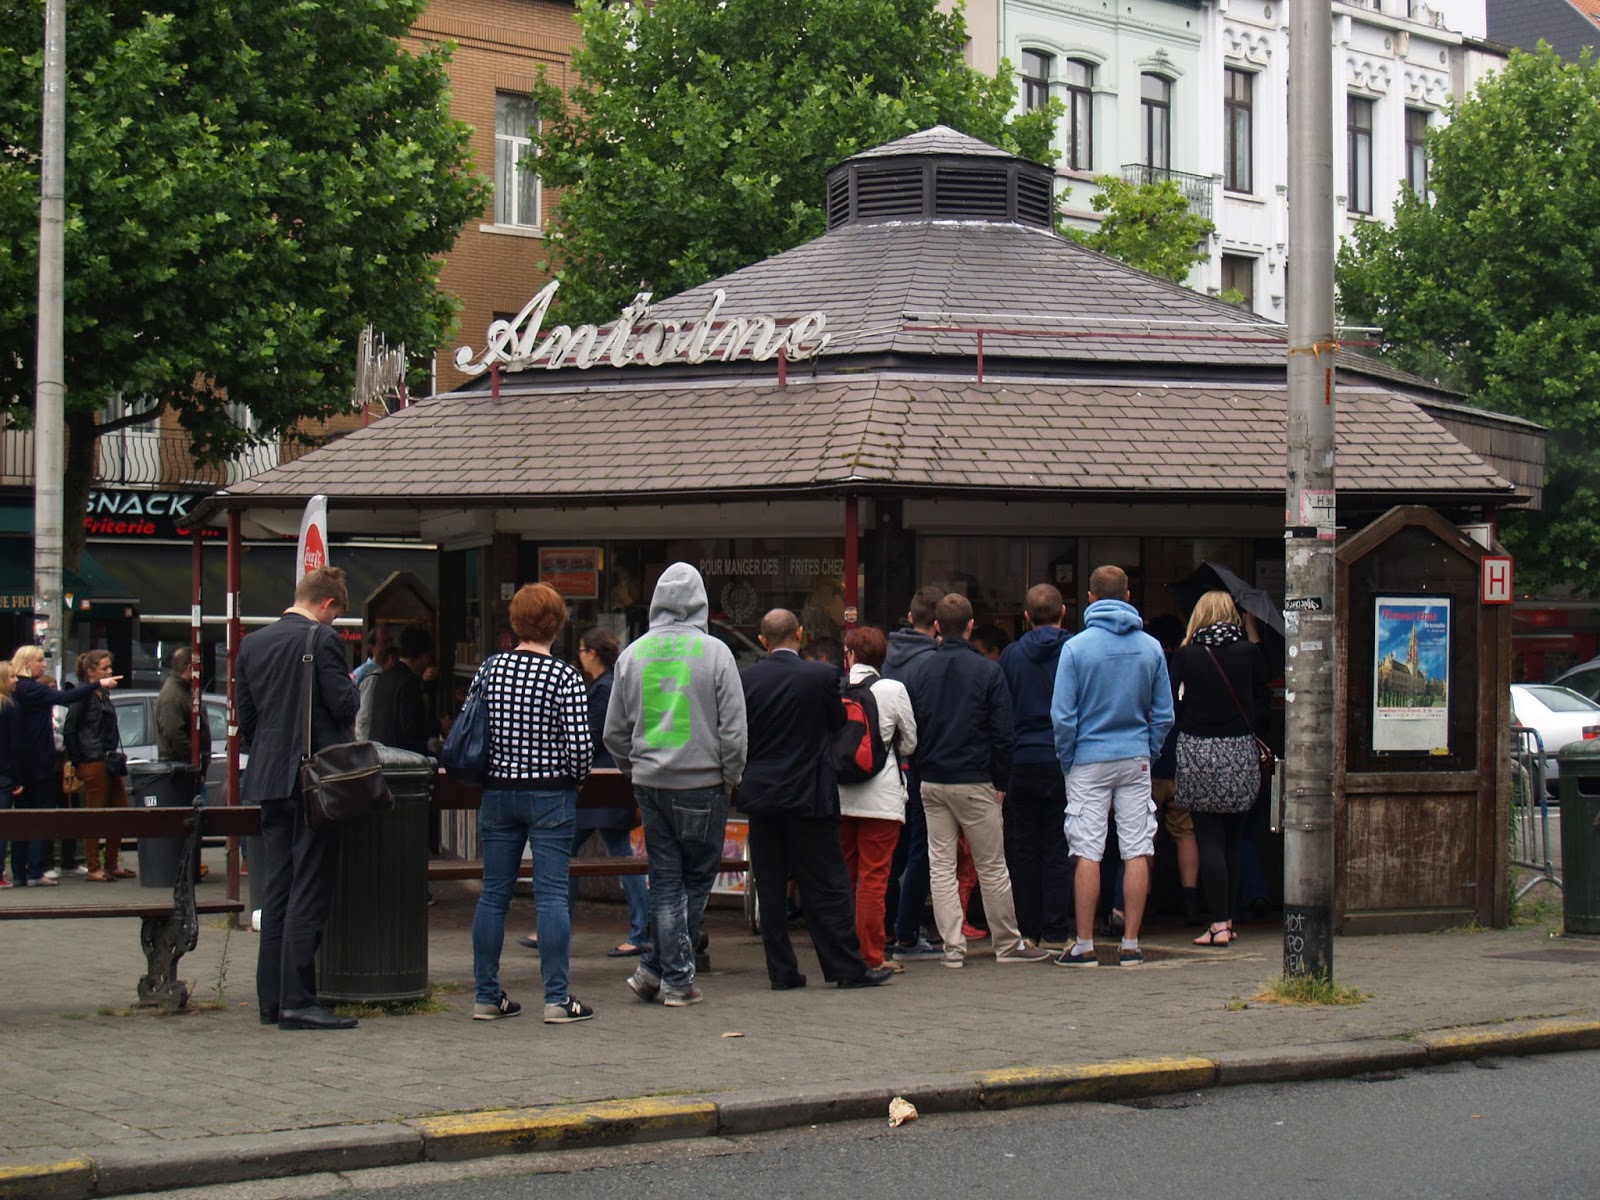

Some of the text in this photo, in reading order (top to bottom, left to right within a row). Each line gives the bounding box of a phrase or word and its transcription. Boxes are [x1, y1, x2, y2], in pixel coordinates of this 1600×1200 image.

[454, 280, 831, 375] Antoine
[87, 491, 193, 516] SNACK
[1317, 495, 1324, 506] H
[84, 517, 156, 535] Friterie
[700, 558, 844, 576] POUR MANGER DES FRITES CHEZ
[1489, 565, 1505, 595] H
[634, 635, 704, 660] OSAKA
[642, 660, 691, 748] 6
[500, 998, 509, 1012] N
[572, 1001, 581, 1015] N
